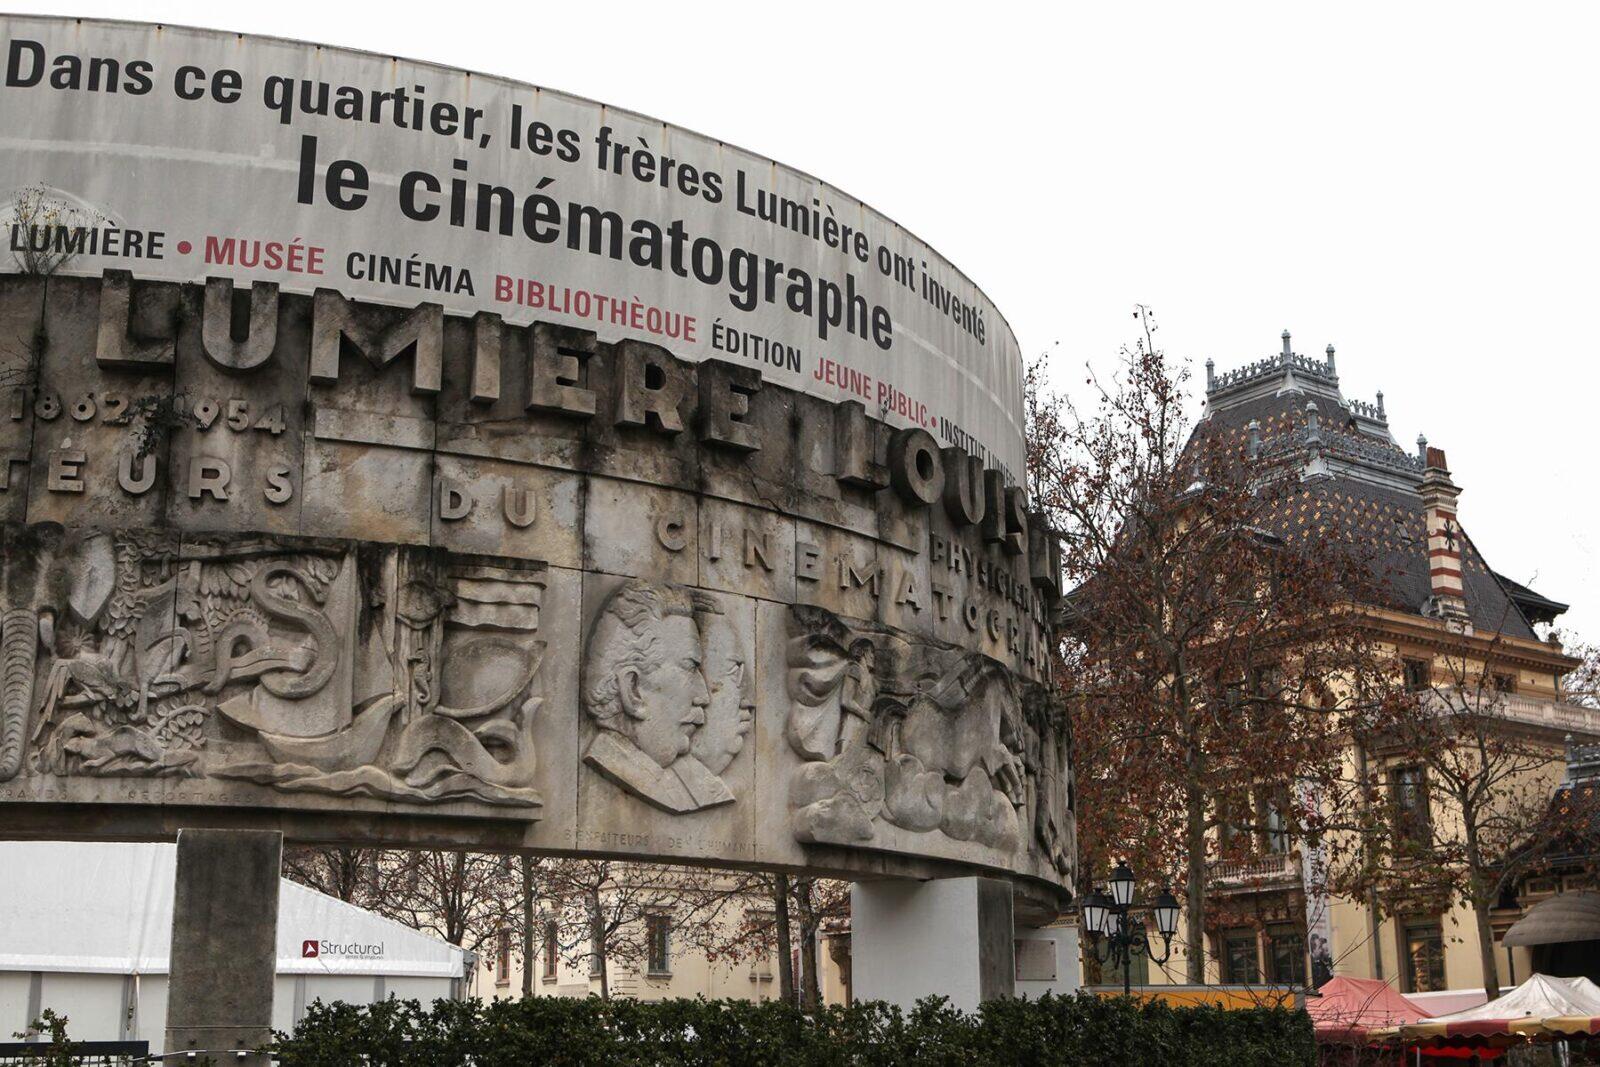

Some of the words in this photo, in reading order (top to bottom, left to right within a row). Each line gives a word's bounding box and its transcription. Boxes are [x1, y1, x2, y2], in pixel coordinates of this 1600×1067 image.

[6, 39, 153, 95] Dans
[174, 64, 243, 104] ce
[263, 75, 490, 149] quartier,
[510, 105, 580, 163] les
[595, 126, 723, 204] frères
[736, 169, 870, 264] Lumière
[878, 244, 916, 293] ont
[921, 261, 987, 347] inventé
[297, 135, 369, 212] le
[399, 159, 893, 351] cinématographe
[10, 220, 165, 260] LUMIÈRE
[204, 236, 325, 275] MUSÉE
[346, 251, 475, 298] CINÉMA
[495, 275, 697, 343] BIBLIOTHÈQUE
[711, 318, 801, 374] ÉDITION
[813, 357, 872, 401] JEUNE
[877, 380, 928, 428] PUBLIC
[940, 416, 985, 460] INSTITUT
[96, 268, 762, 452] LUMIERE
[438, 480, 537, 527] DU
[320, 940, 384, 954] Structural
